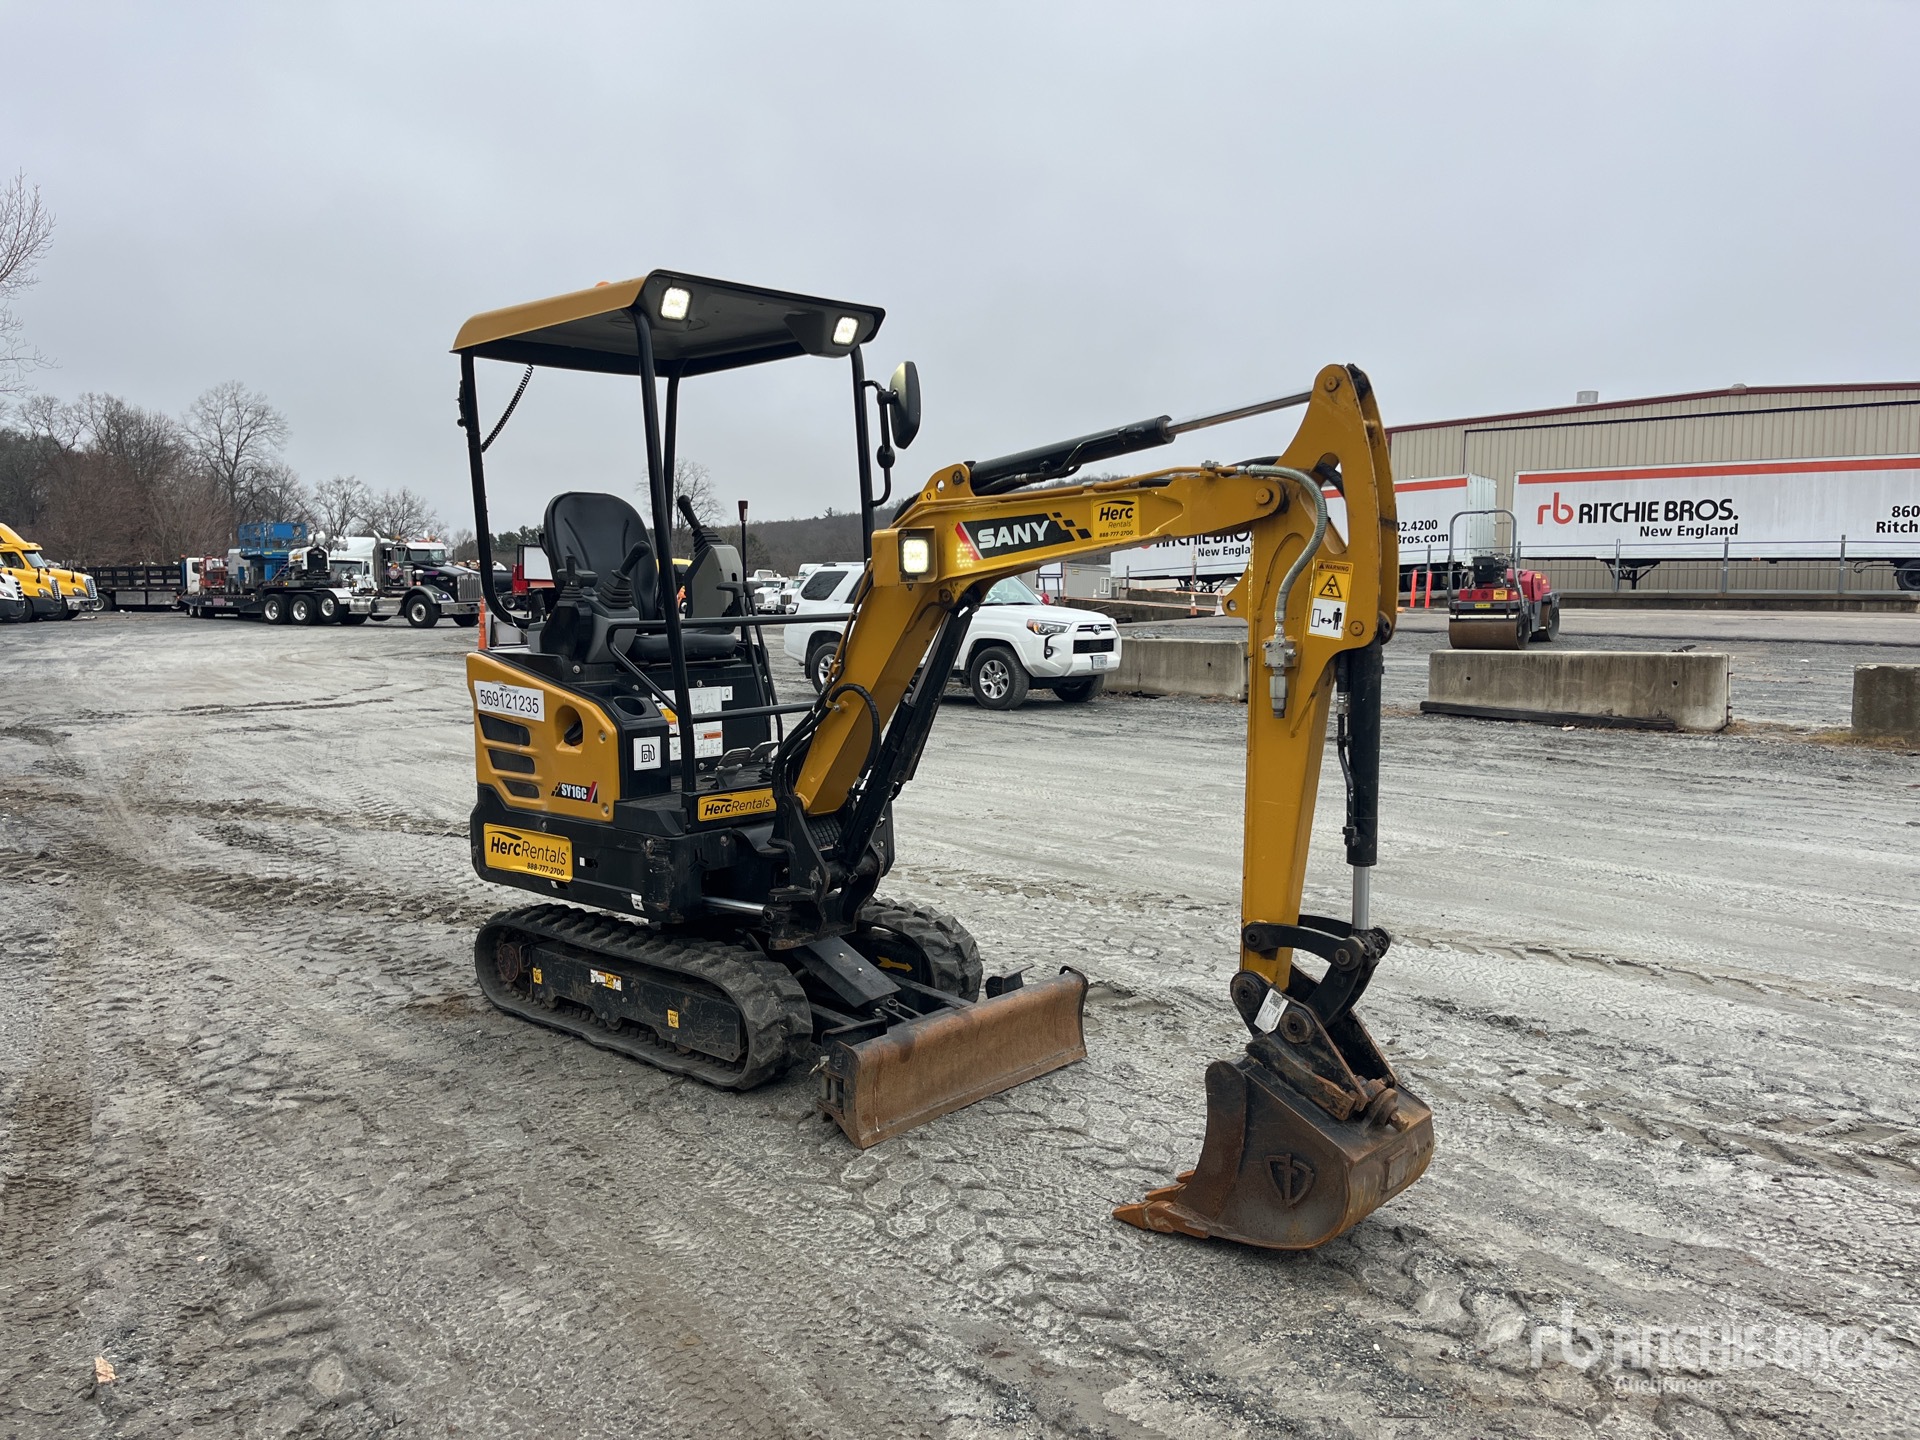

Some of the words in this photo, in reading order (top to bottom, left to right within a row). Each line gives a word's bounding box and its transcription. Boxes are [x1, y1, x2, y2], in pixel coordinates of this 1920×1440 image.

[1098, 506, 1134, 521] Herc
[1578, 501, 1660, 524] RITCHIE
[1663, 499, 1739, 522] BROS.
[1891, 505, 1920, 518] 860
[1108, 520, 1132, 529] Rentals
[1640, 526, 1672, 537] New
[1677, 523, 1739, 539] England
[1876, 520, 1919, 533] Ritch
[977, 519, 1050, 550] SANY
[1099, 530, 1134, 538] 888-777-2700
[1198, 547, 1220, 557] New
[1325, 564, 1349, 573] WARNING
[480, 689, 540, 714] 569121235
[561, 783, 588, 800] SY16C
[704, 796, 771, 816] HercRentals
[490, 836, 567, 865] HercRentals
[526, 861, 565, 877] 888-777-2700
